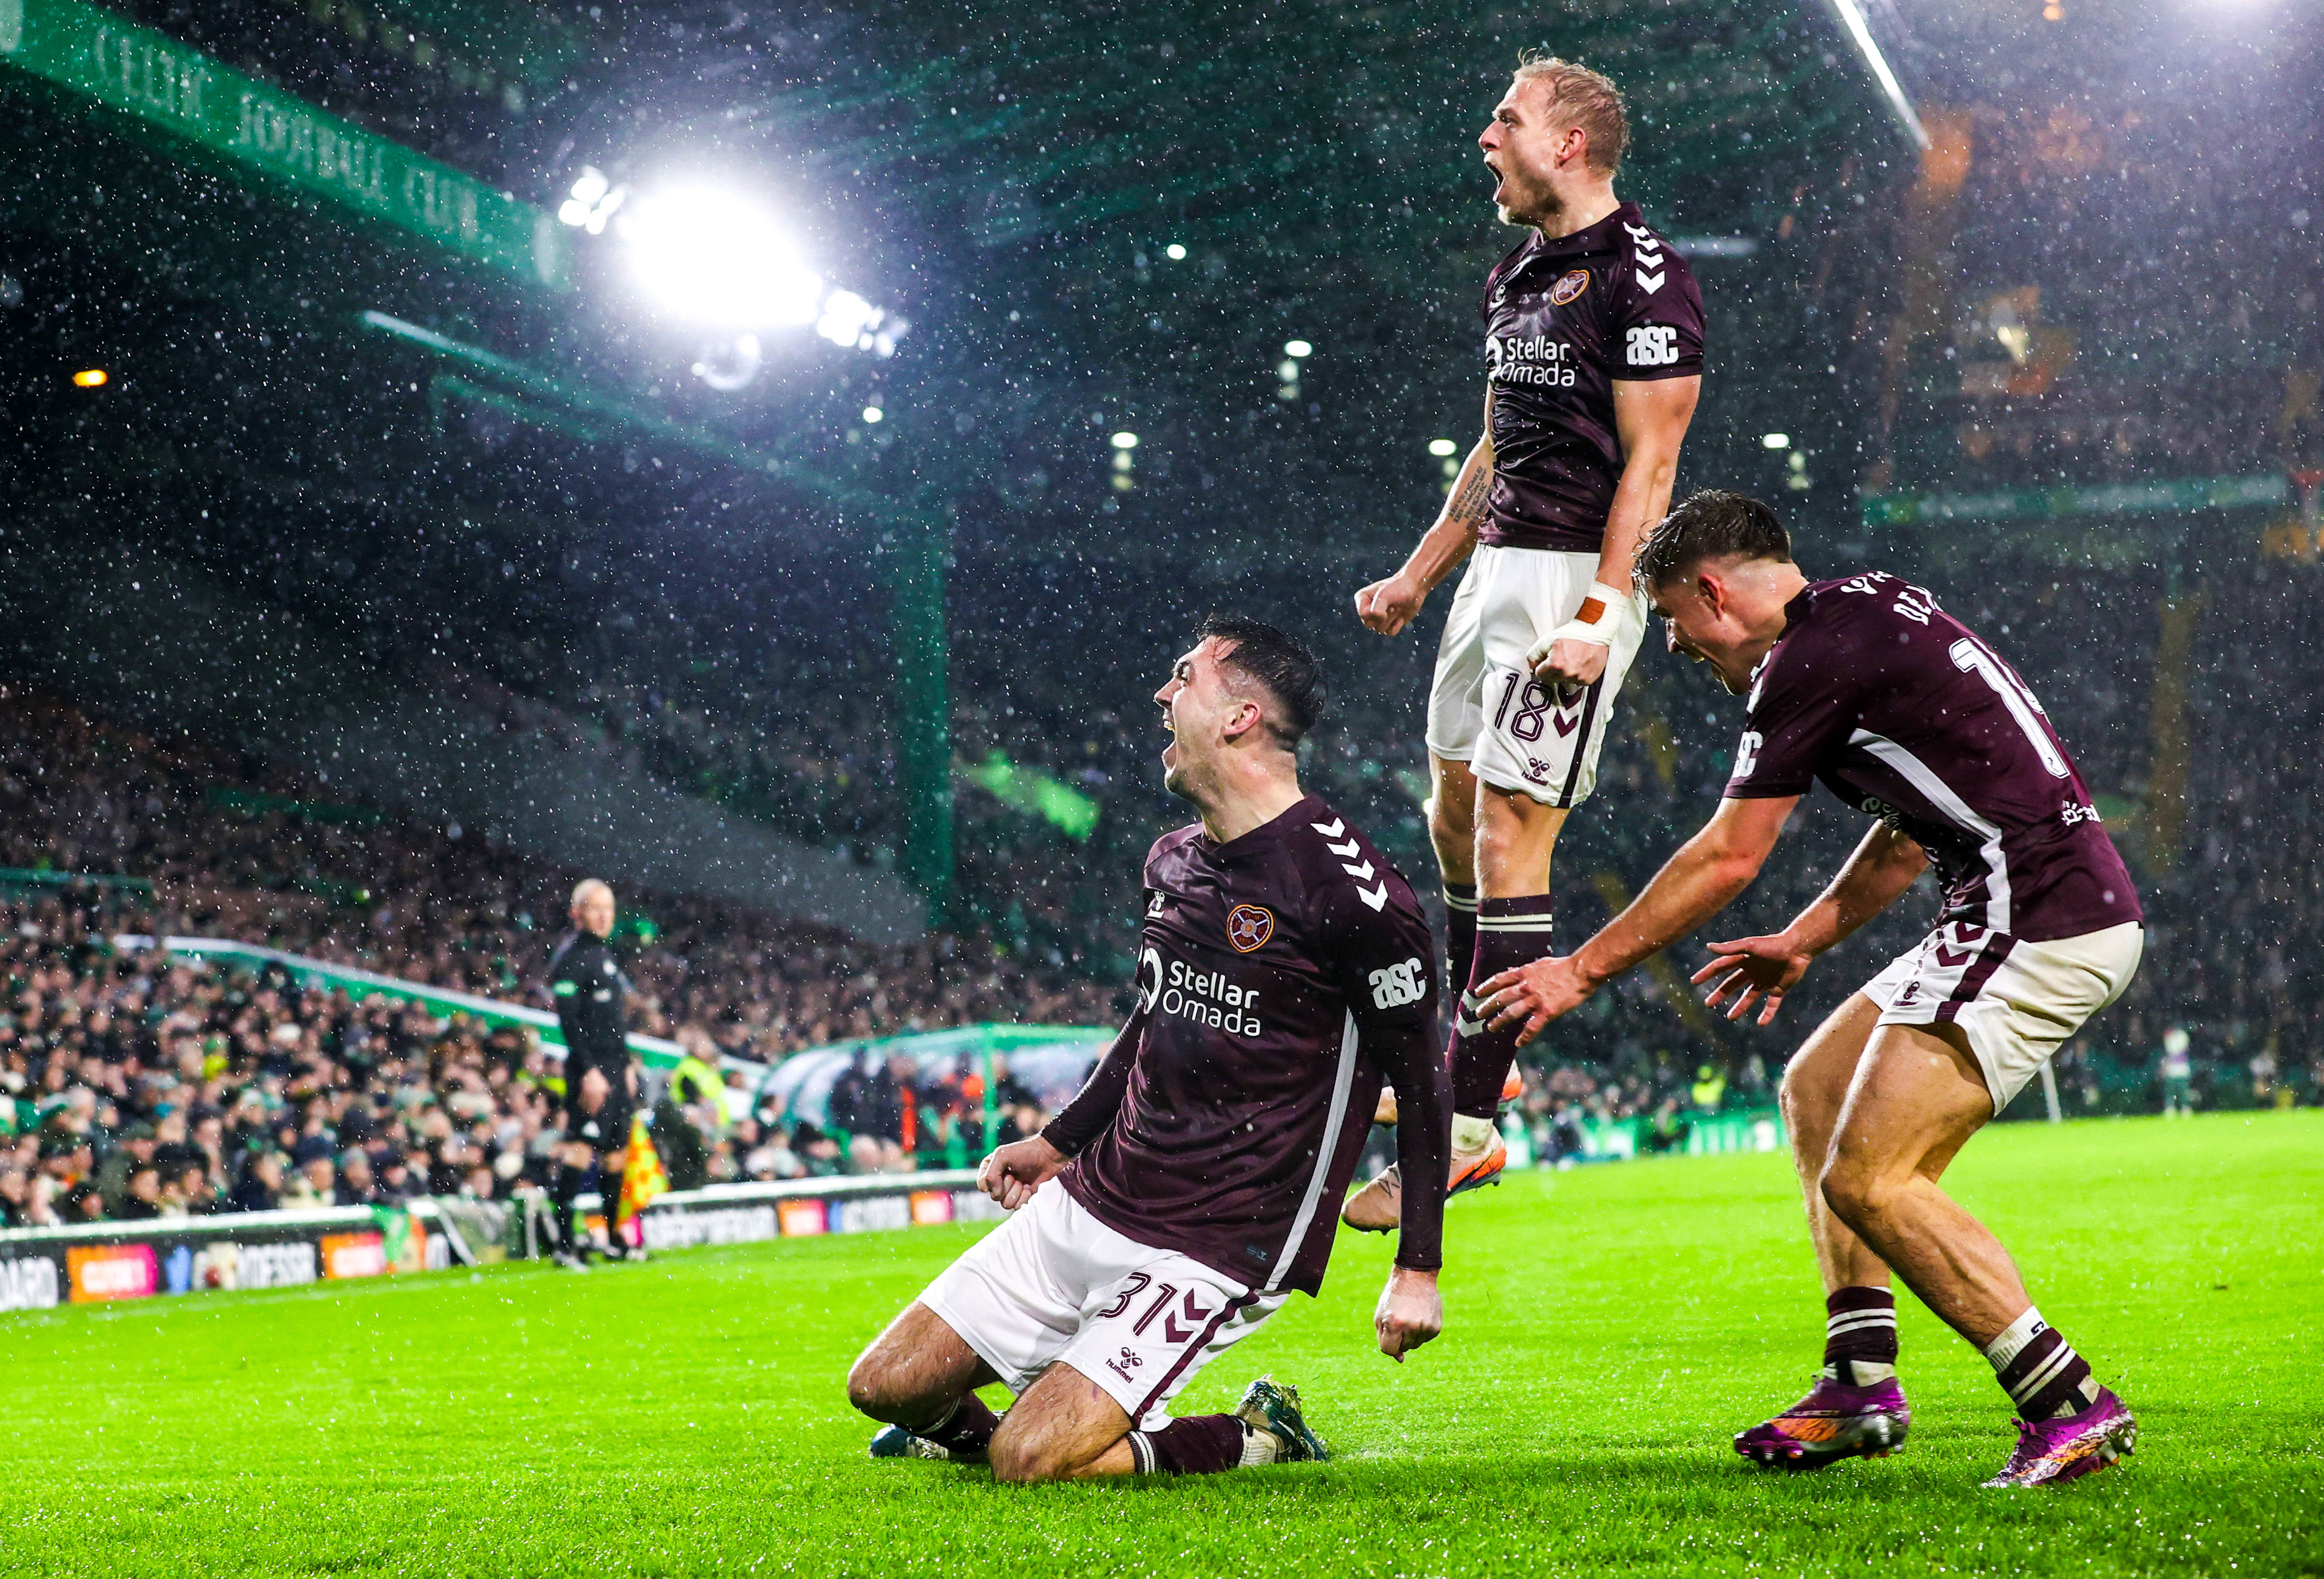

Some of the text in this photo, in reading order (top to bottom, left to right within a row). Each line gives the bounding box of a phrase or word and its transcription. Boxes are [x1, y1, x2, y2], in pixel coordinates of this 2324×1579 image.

[1506, 336, 1571, 361] Stellar
[1626, 326, 1679, 365] asc
[1500, 362, 1576, 387] Omada
[1494, 673, 1553, 742] 18
[1168, 960, 1260, 1009] Stellar
[1368, 957, 1426, 1010] asc
[1162, 987, 1261, 1037] Omada
[1095, 1271, 1181, 1338] 31
[1105, 1358, 1134, 1384] hummel
